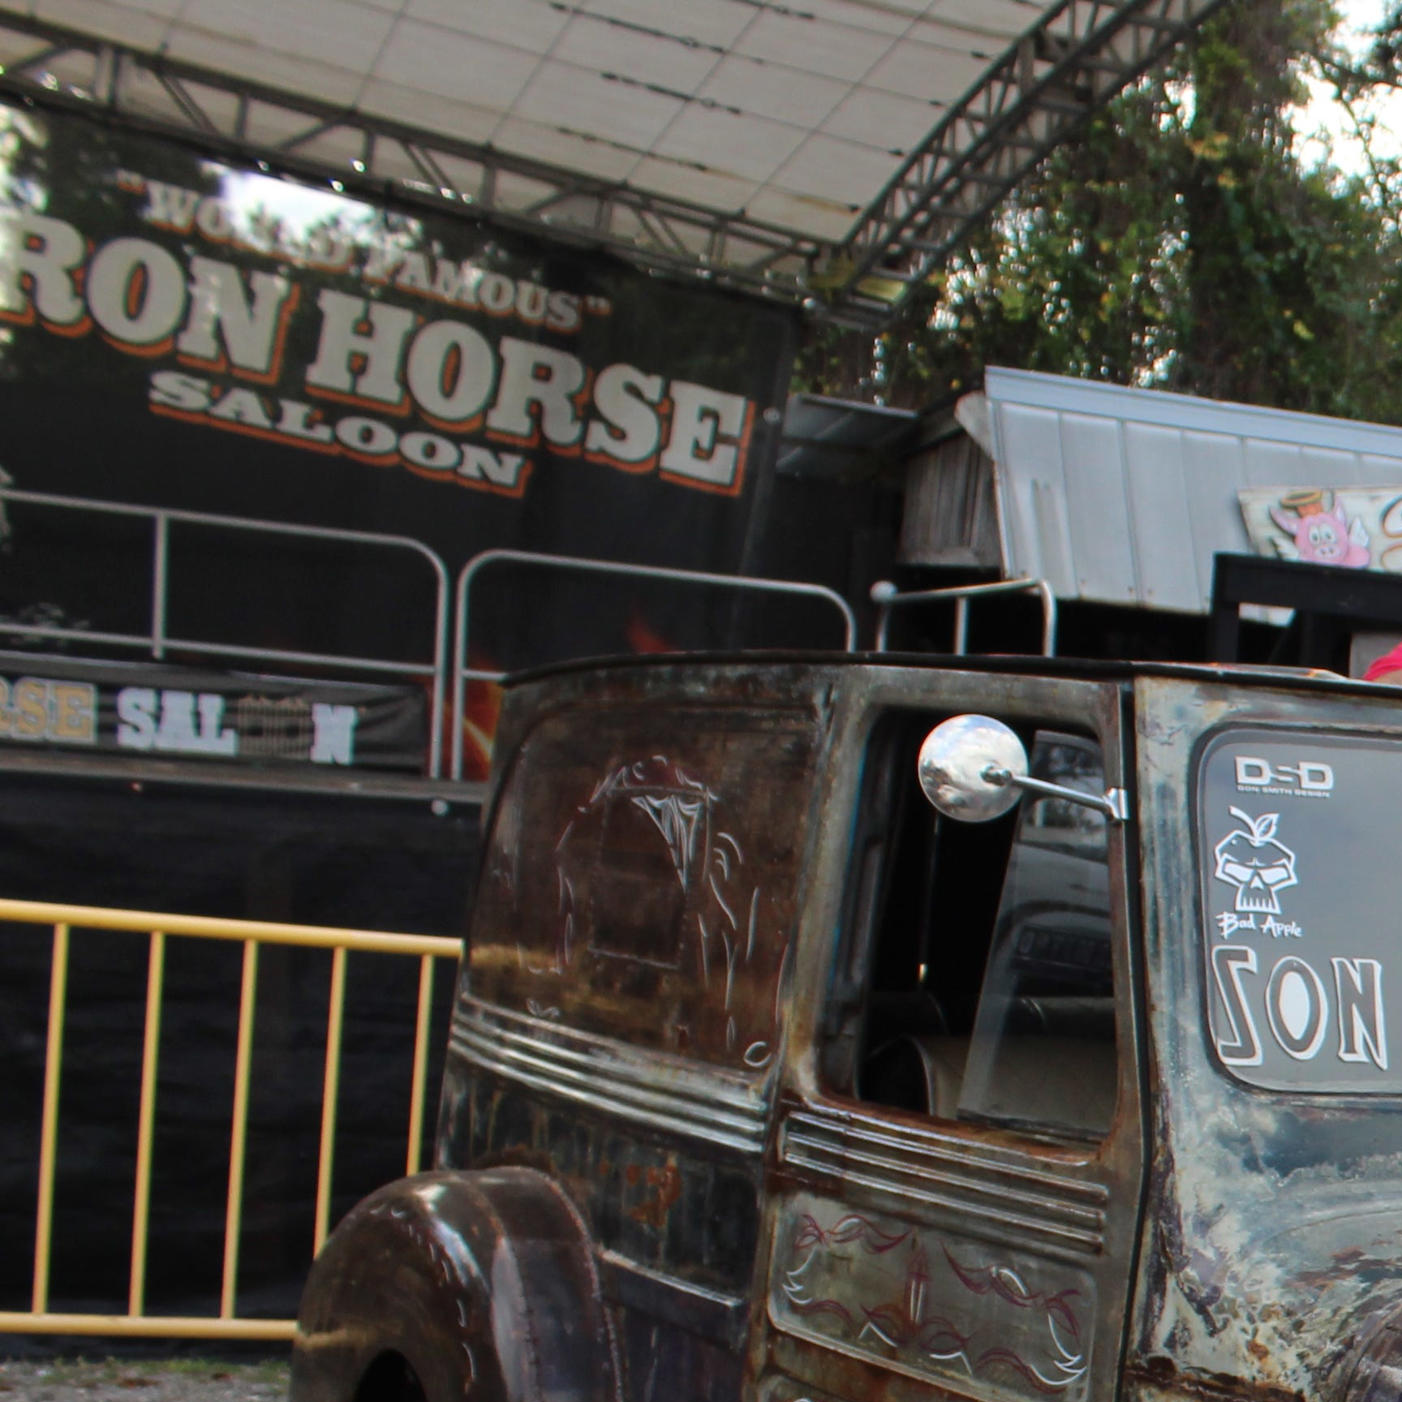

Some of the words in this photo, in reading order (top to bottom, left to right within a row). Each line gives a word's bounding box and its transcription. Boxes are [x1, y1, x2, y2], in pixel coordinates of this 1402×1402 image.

[0, 210, 299, 386] RON
[305, 288, 755, 498] HORSE
[149, 370, 533, 499] SALOON
[0, 676, 98, 745] SE
[1215, 911, 1256, 940] Bad
[1260, 914, 1303, 938] Apple
[1211, 944, 1388, 1071] SON
